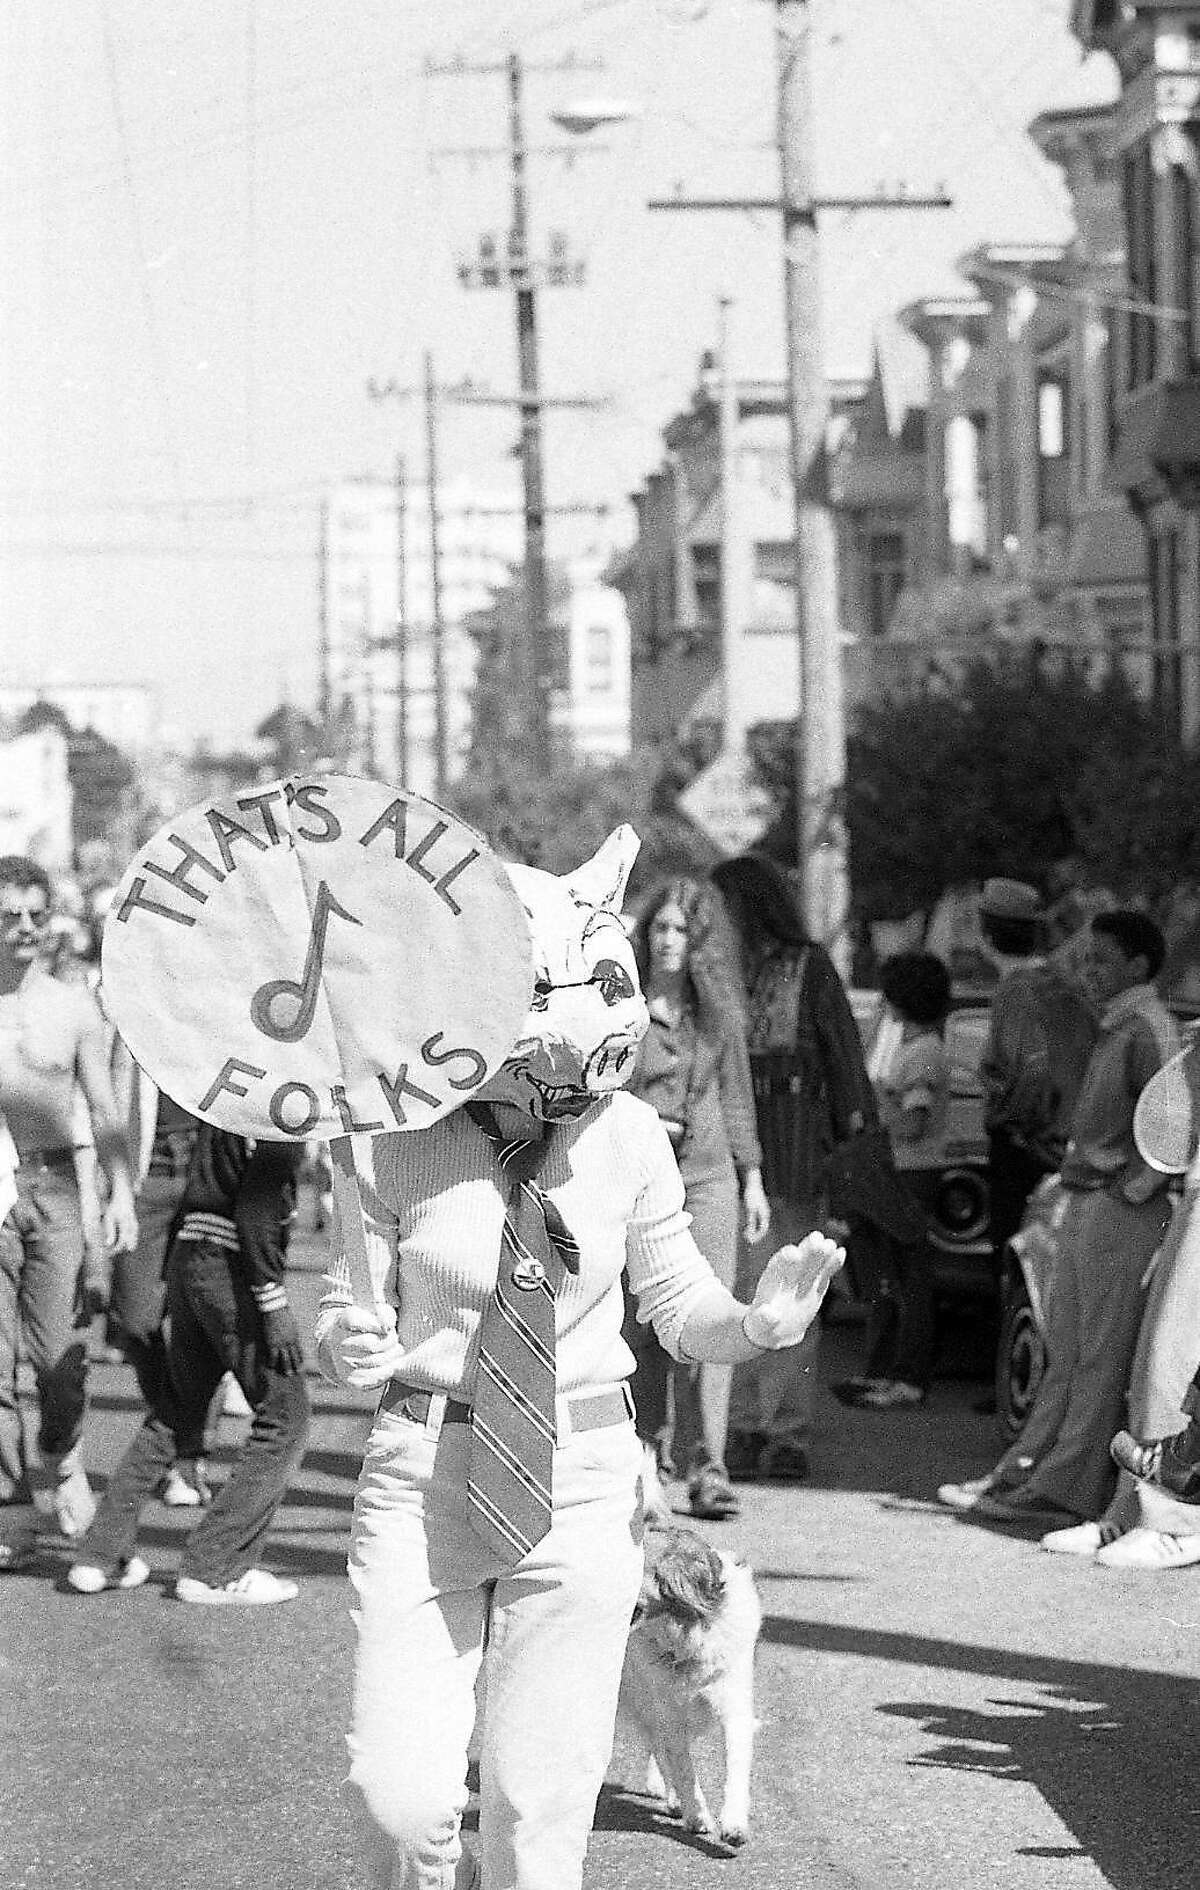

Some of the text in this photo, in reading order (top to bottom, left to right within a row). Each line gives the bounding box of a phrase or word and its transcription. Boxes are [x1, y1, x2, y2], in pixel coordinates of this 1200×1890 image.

[116, 783, 481, 927] THAT'S ALL
[198, 1031, 488, 1136] FOLKS
